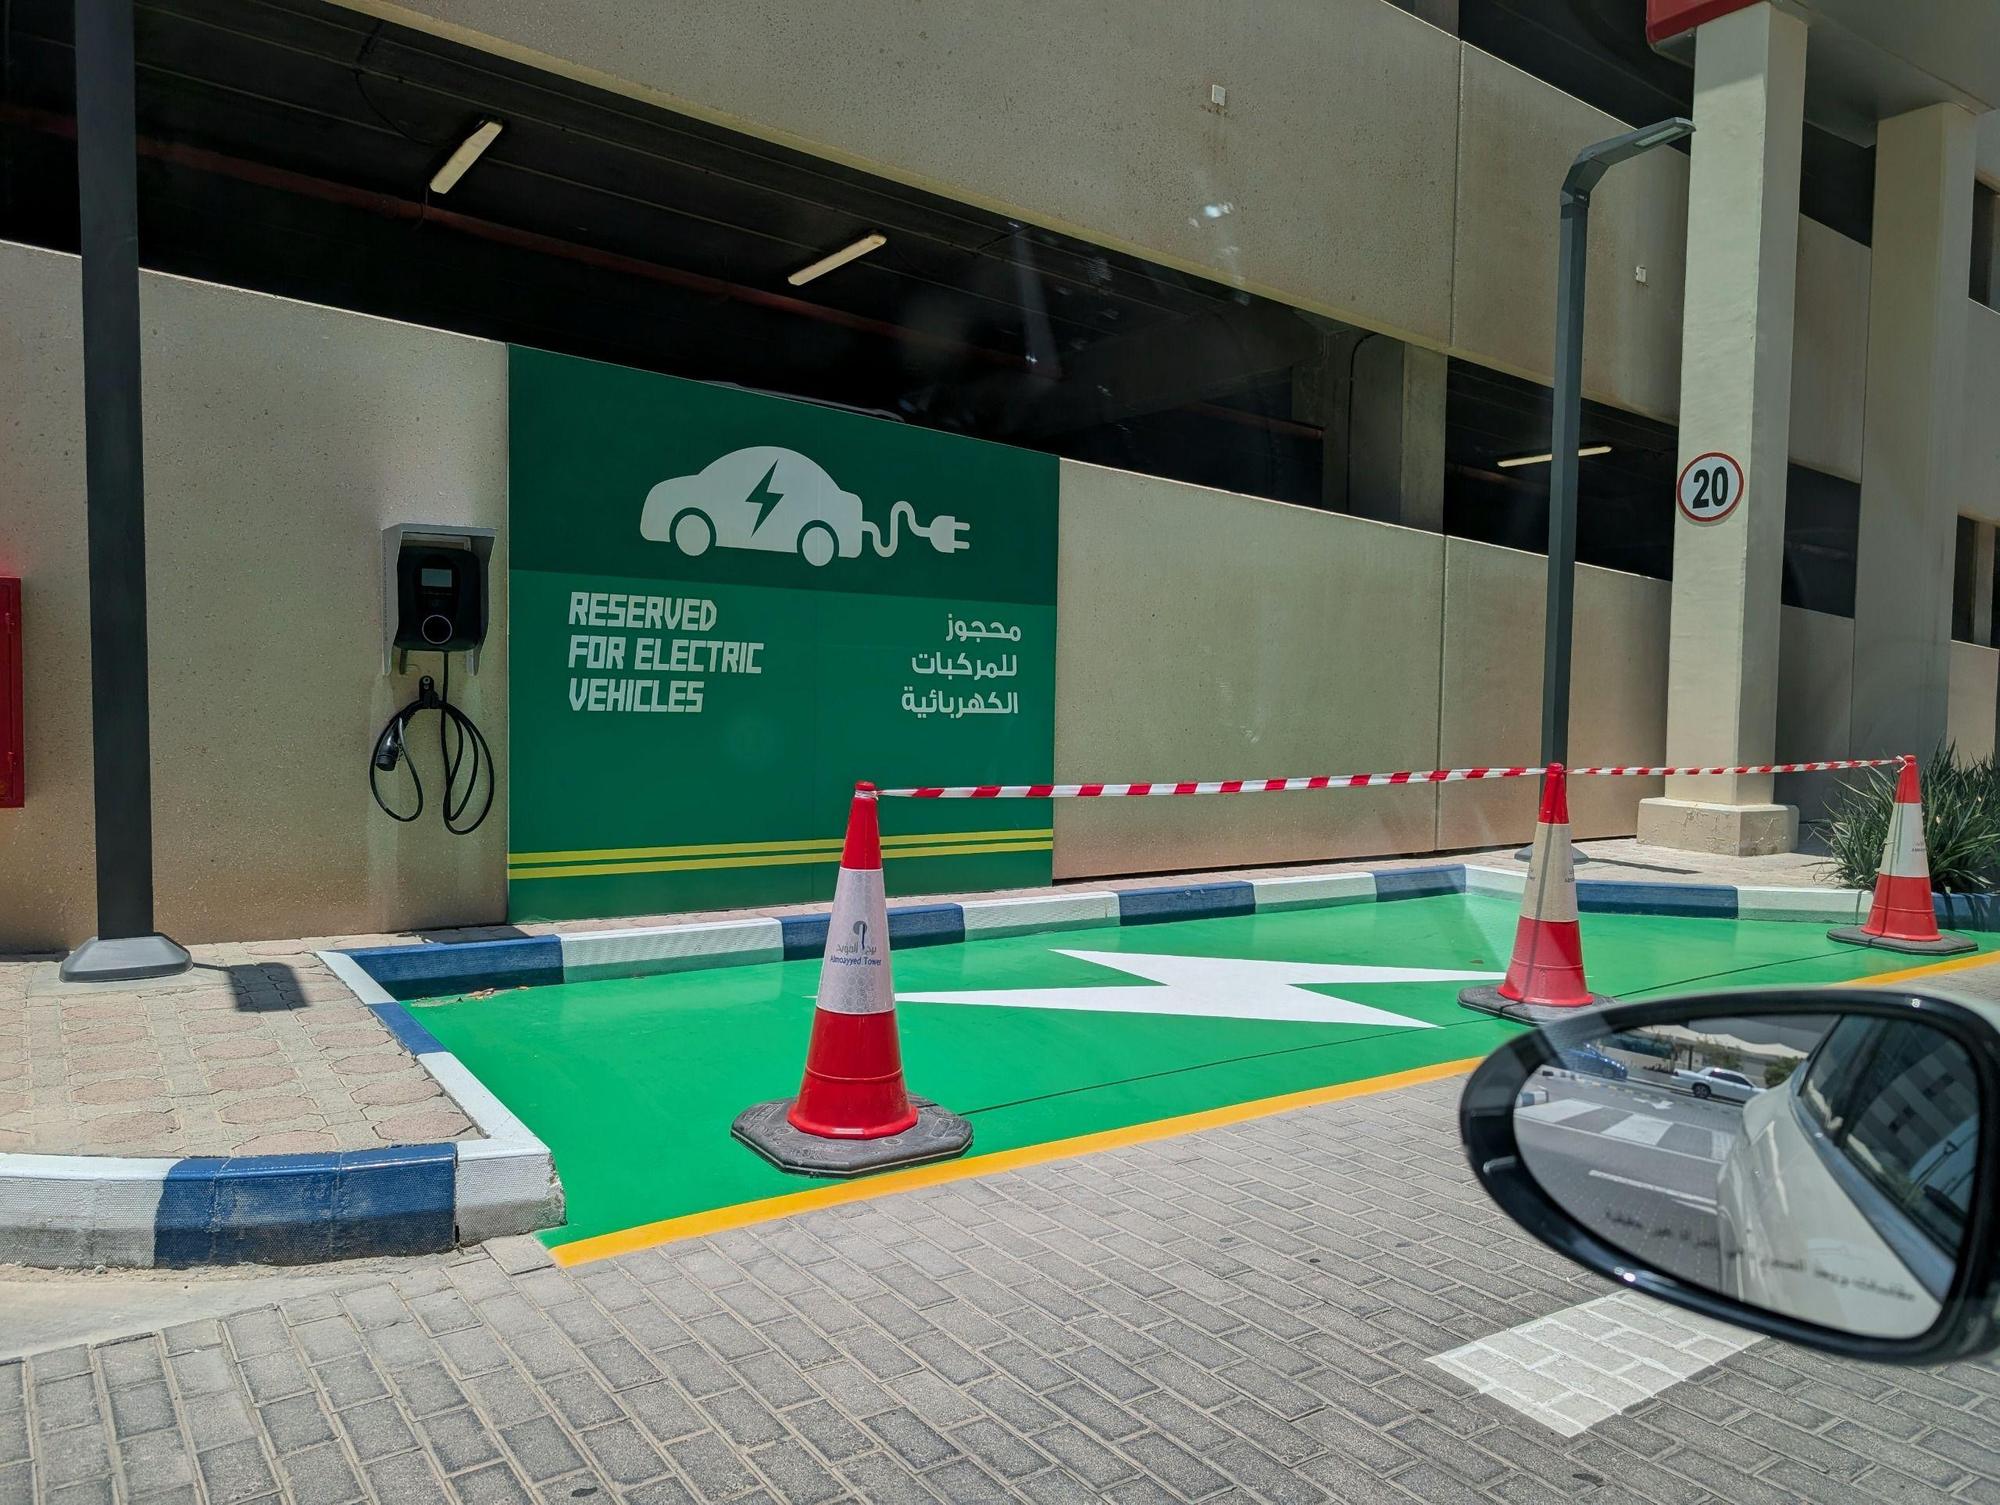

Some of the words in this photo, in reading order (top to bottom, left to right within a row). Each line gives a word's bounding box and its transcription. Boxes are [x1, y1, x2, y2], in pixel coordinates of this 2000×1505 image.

[1692, 466, 1729, 509] 20
[568, 591, 717, 631] RESERVED
[945, 613, 1022, 643] محجوز
[568, 634, 626, 669] FOR
[634, 637, 765, 674] ELECTRIC
[911, 651, 1017, 681] للمركبات
[568, 677, 705, 713] VEHICLES
[901, 686, 1019, 719] الكهربائية
[863, 956, 882, 966] Tower
